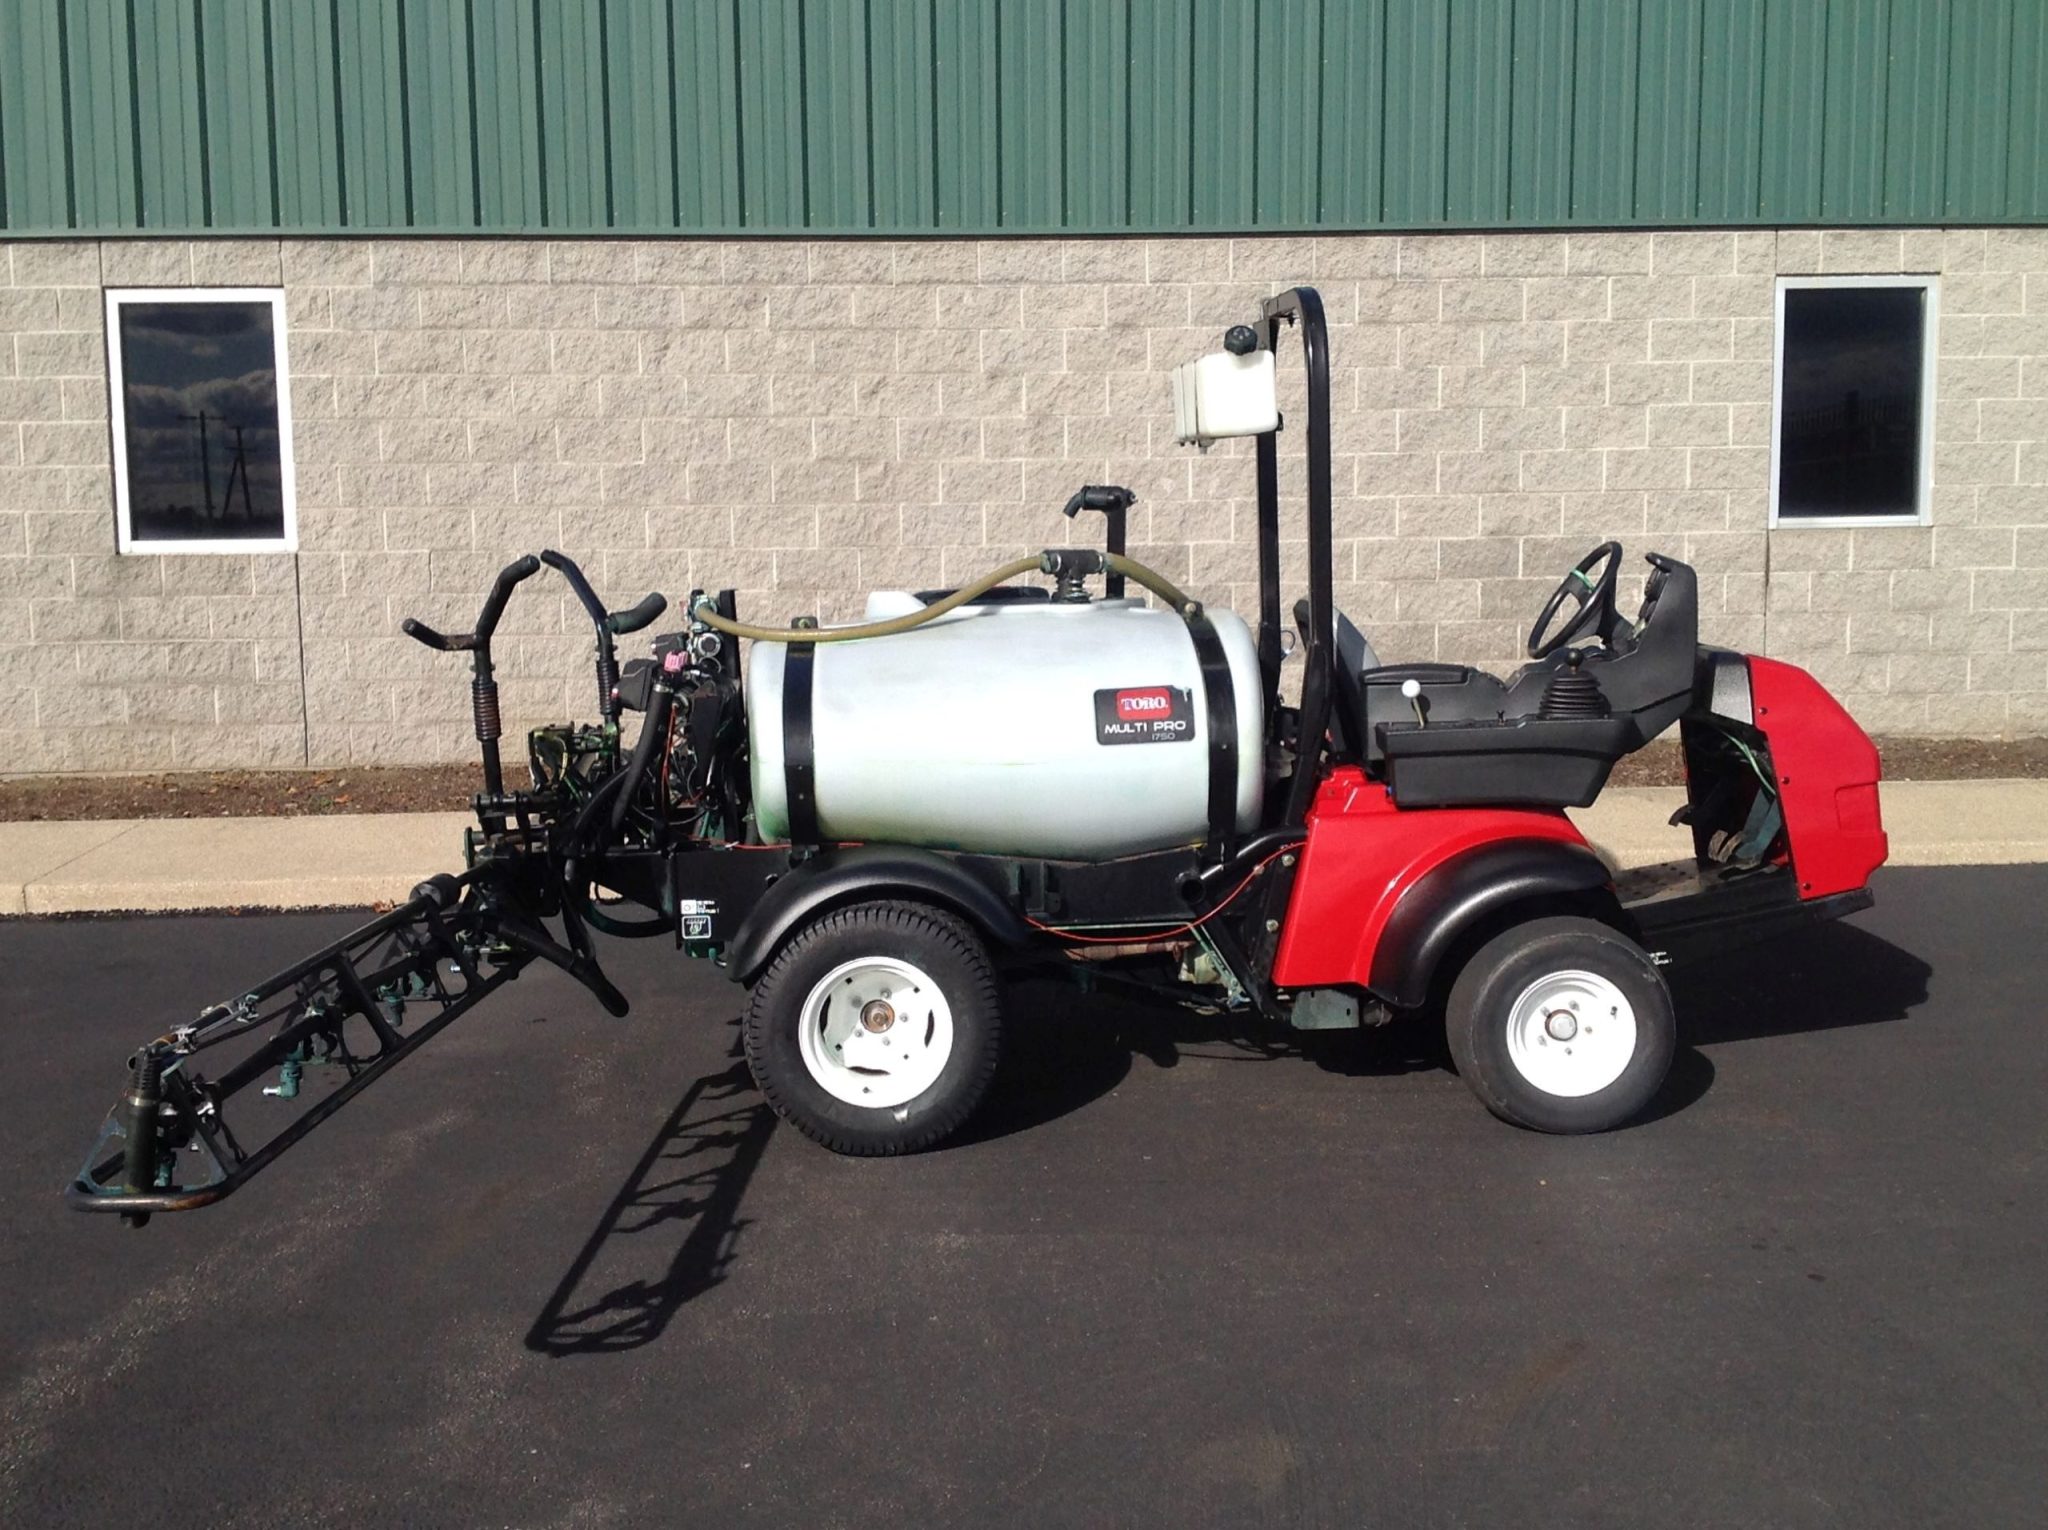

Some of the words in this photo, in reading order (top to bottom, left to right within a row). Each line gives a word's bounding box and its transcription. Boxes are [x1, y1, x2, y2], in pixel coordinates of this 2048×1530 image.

[1121, 696, 1167, 711] TORO
[1104, 722, 1147, 734] MULTI
[1153, 720, 1187, 732] PRO
[1151, 732, 1176, 741] 1750
